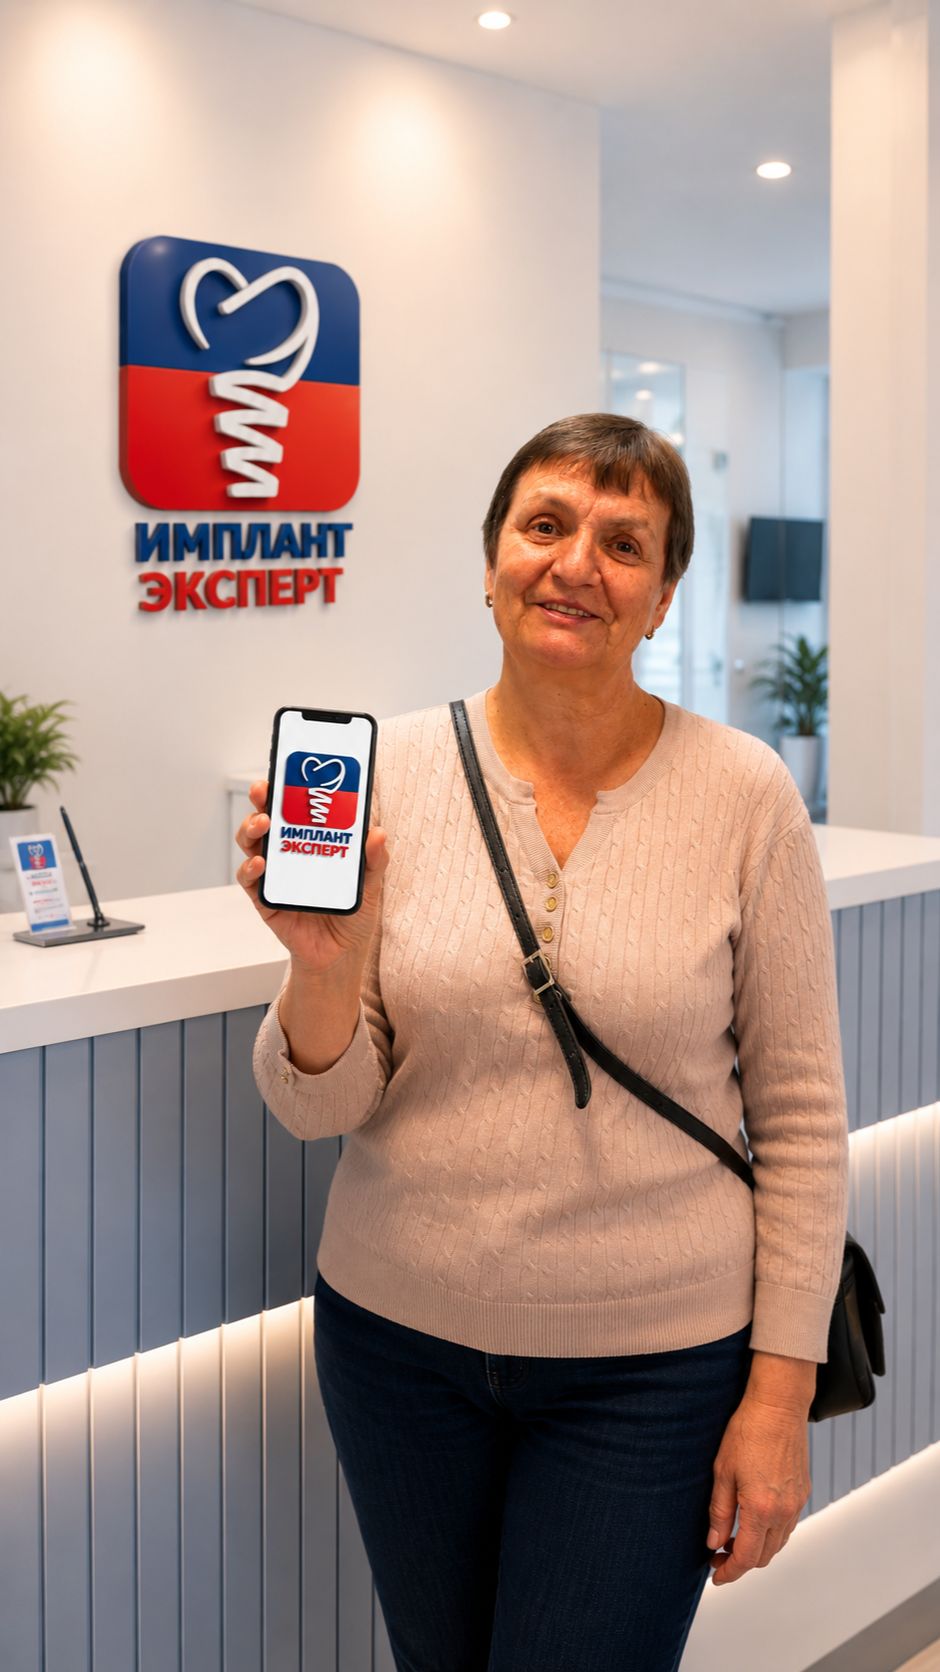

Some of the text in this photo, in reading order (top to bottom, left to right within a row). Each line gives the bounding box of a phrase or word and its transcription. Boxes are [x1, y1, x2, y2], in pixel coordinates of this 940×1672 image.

[134, 522, 353, 563] ИМПЛАНТ
[138, 567, 343, 612] ЭКСПЕРТ
[280, 826, 353, 844] ИМПЛАНТ
[280, 840, 349, 858] ЭКСПЕРТ
